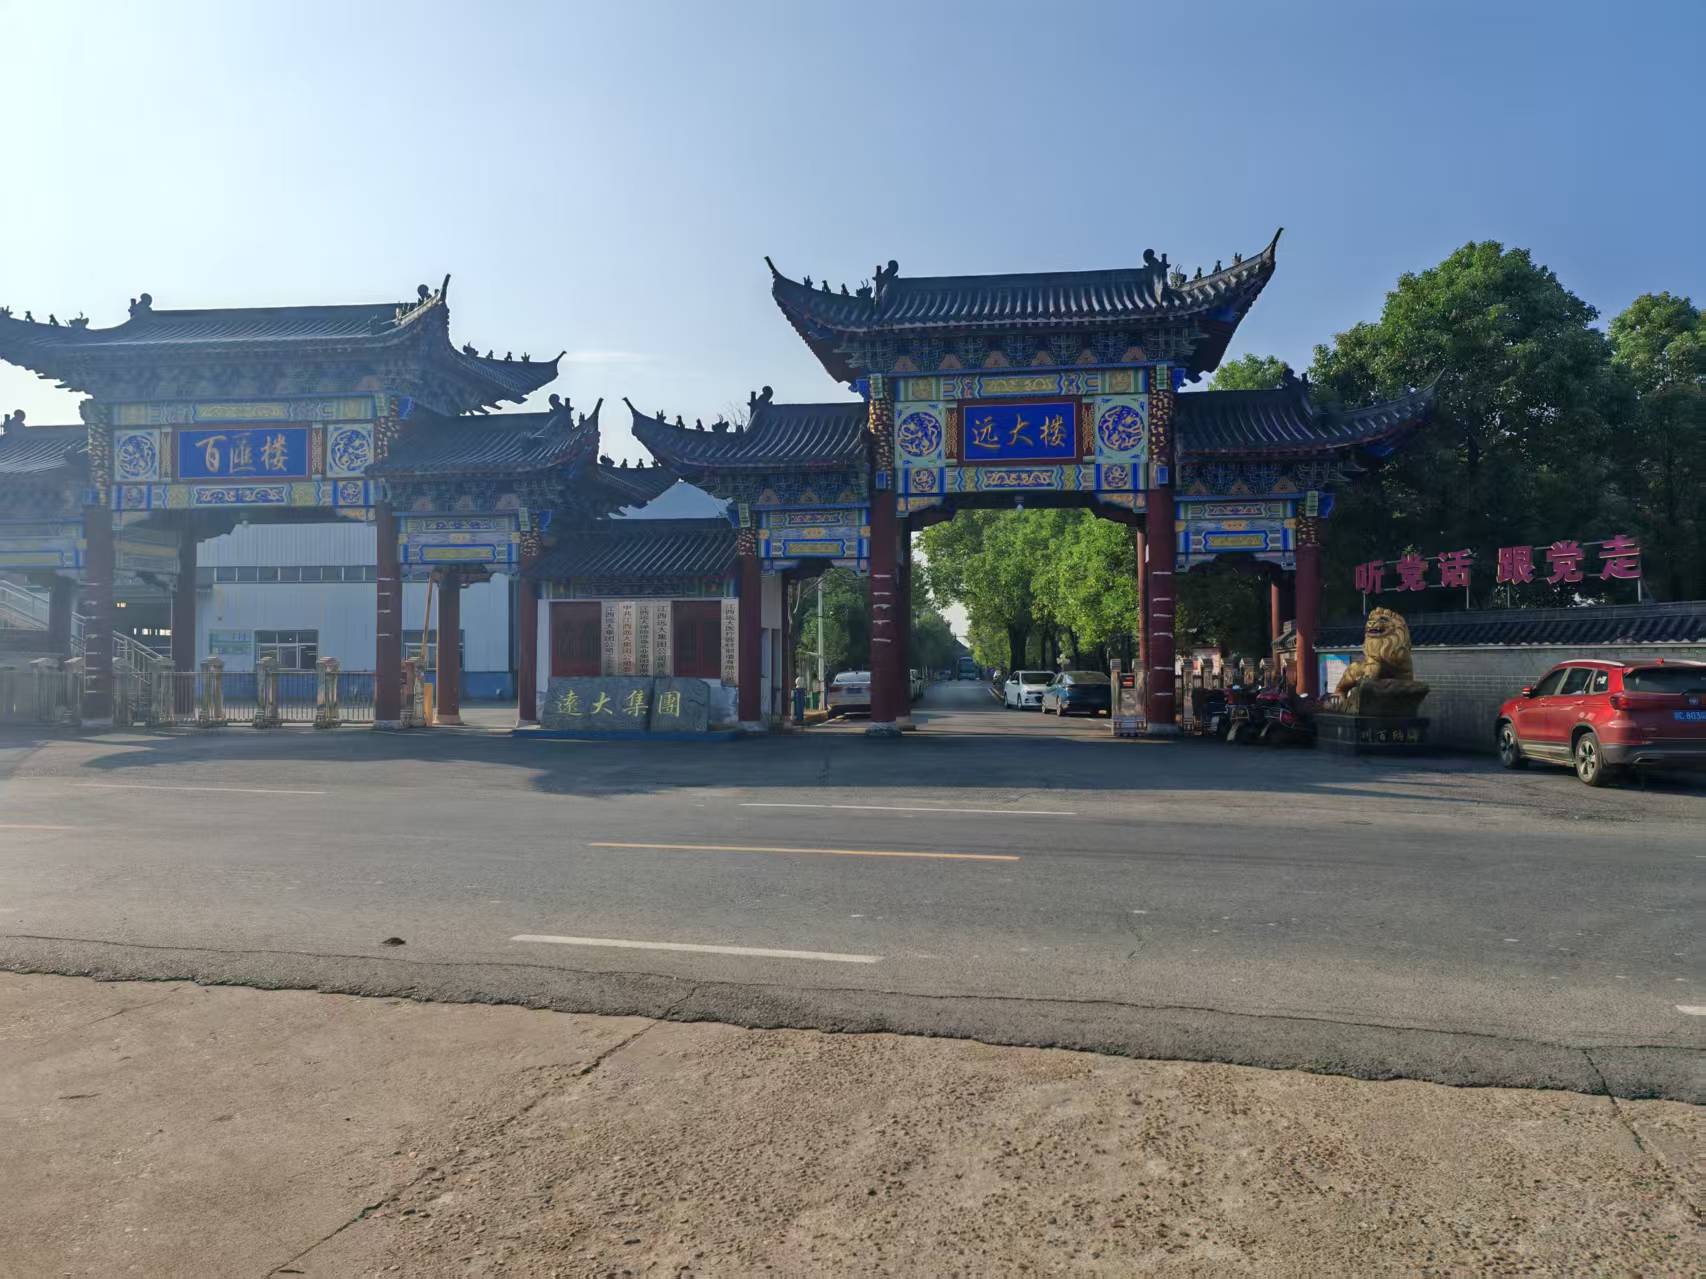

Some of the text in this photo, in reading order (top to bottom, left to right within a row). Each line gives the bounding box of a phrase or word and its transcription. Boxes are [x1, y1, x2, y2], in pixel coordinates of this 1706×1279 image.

[971, 413, 1066, 449] 远大楼
[1353, 534, 1642, 594] 听党话 跟党走
